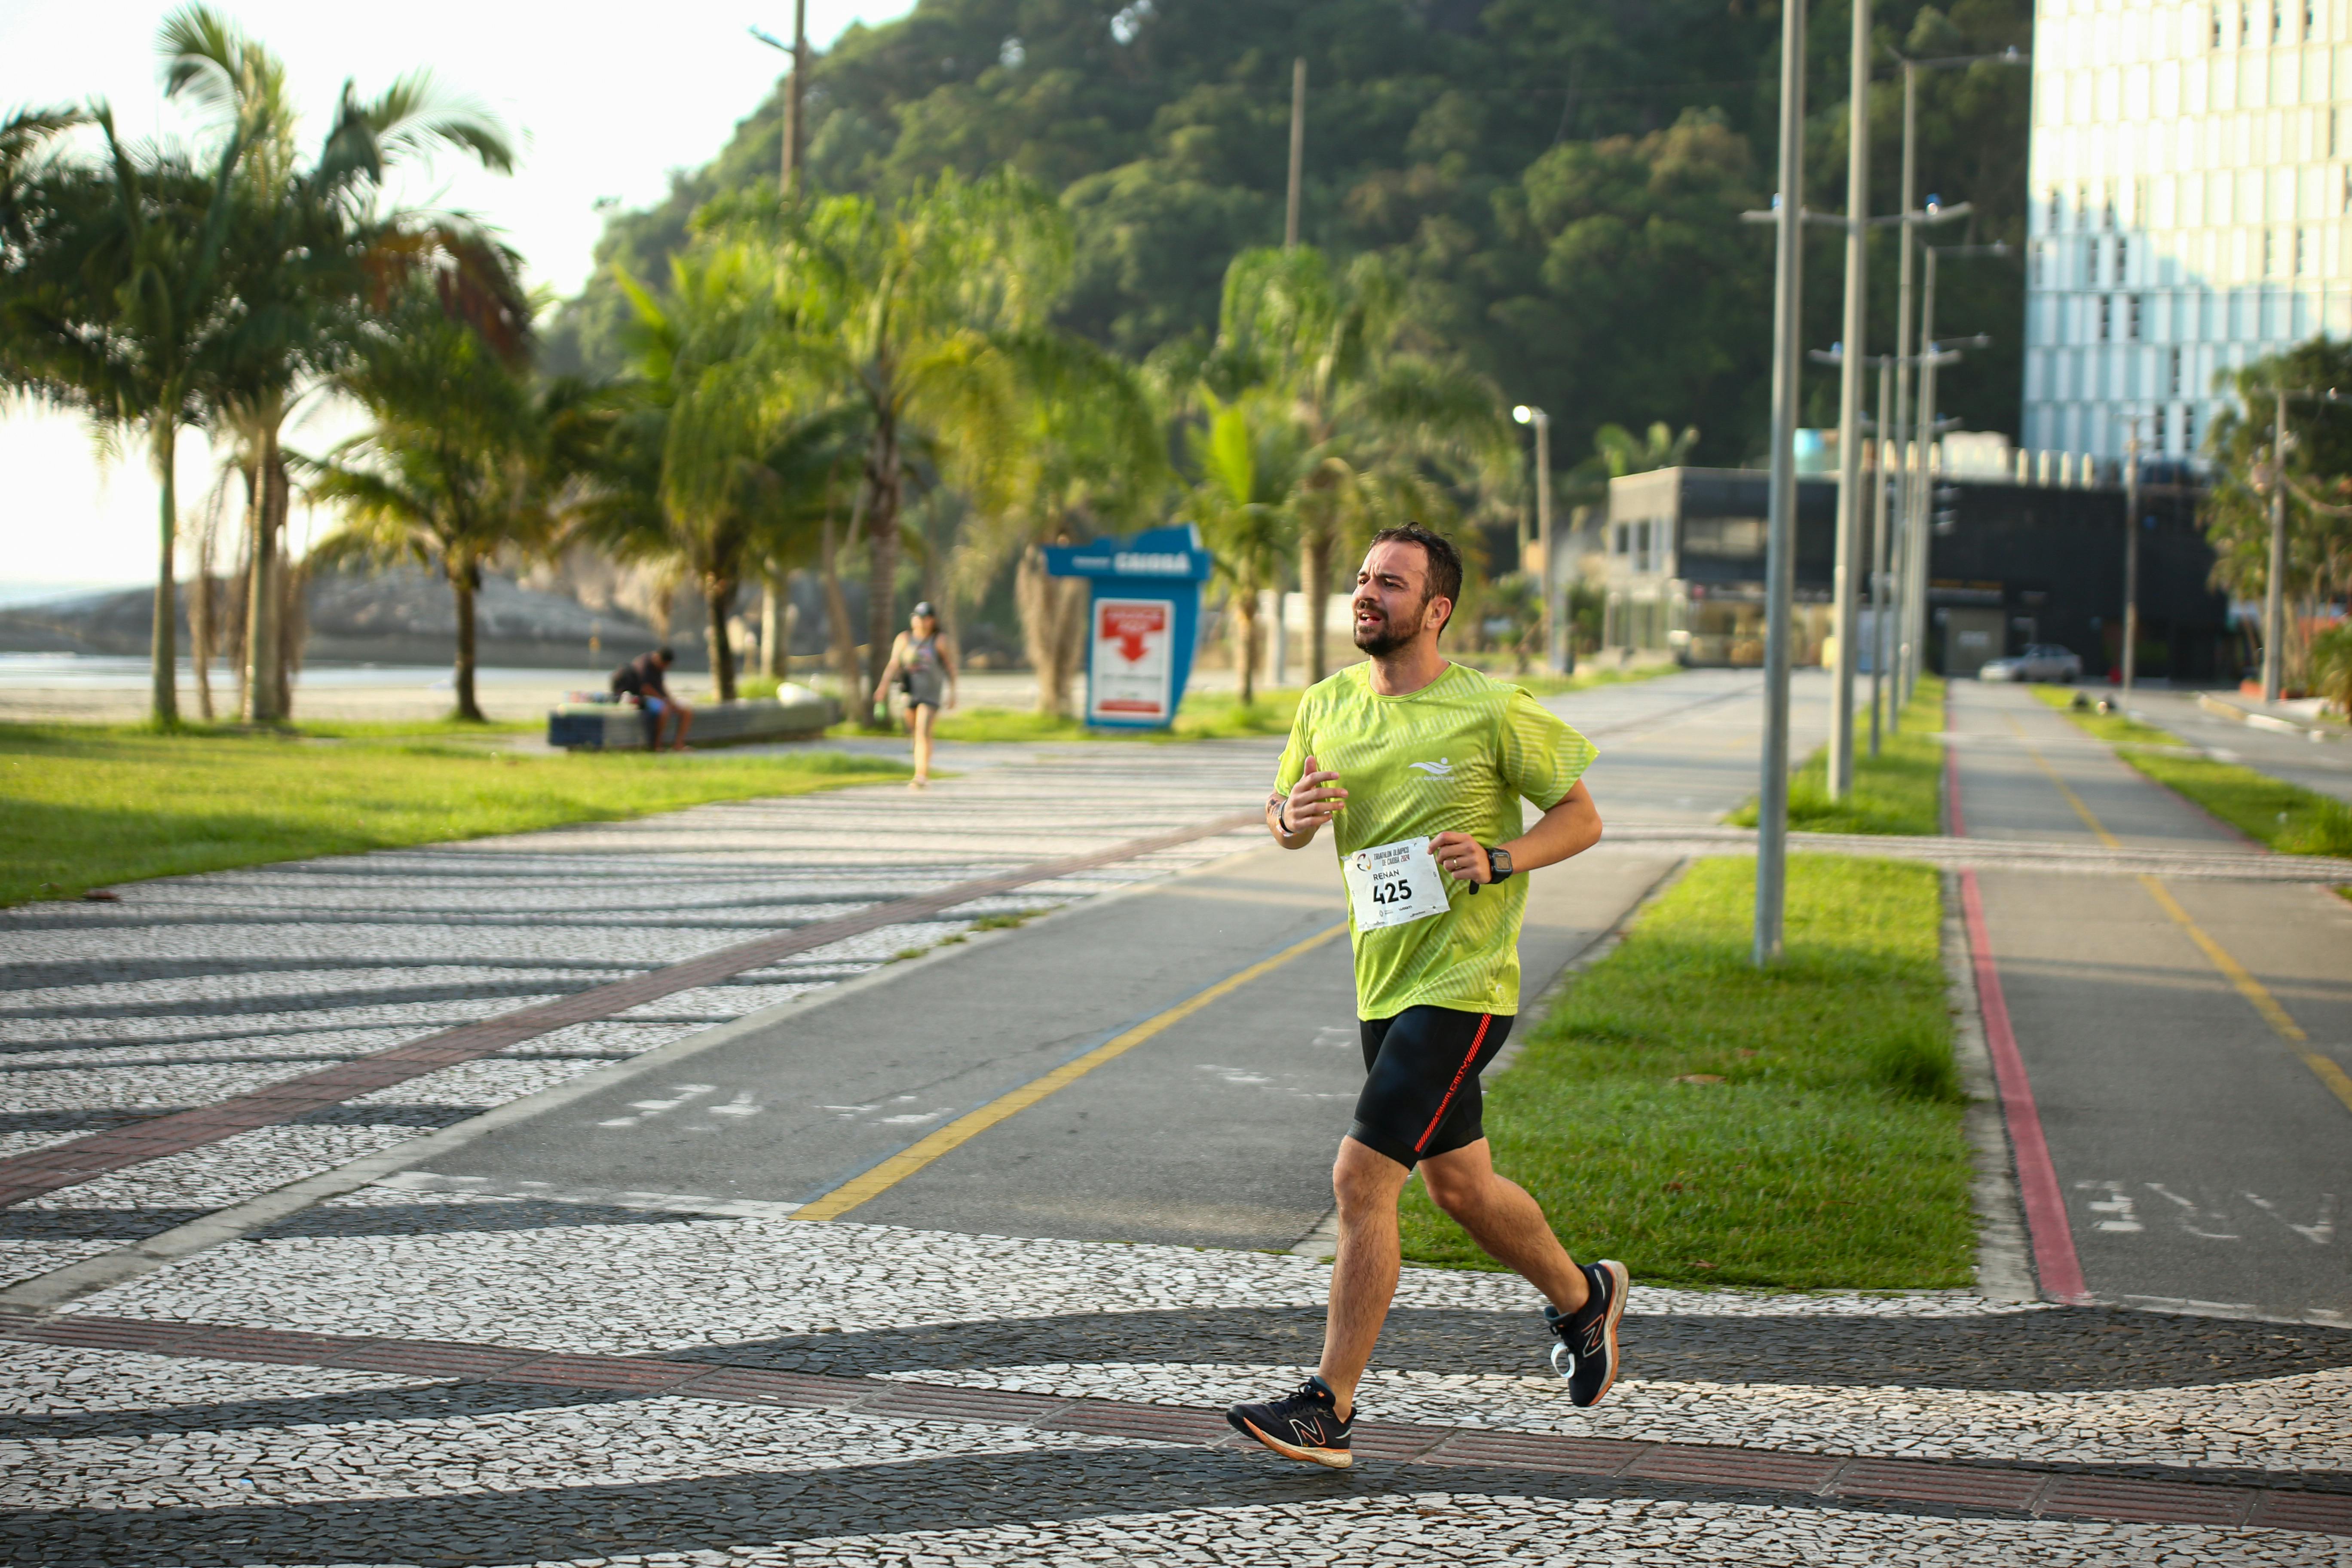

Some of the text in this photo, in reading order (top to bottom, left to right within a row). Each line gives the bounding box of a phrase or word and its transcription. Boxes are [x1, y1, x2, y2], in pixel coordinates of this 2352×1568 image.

[1374, 850, 1392, 860] TRIATHLON
[1401, 854, 1410, 862] 2024
[1373, 869, 1400, 881] RENAN
[1373, 879, 1412, 904] 425
